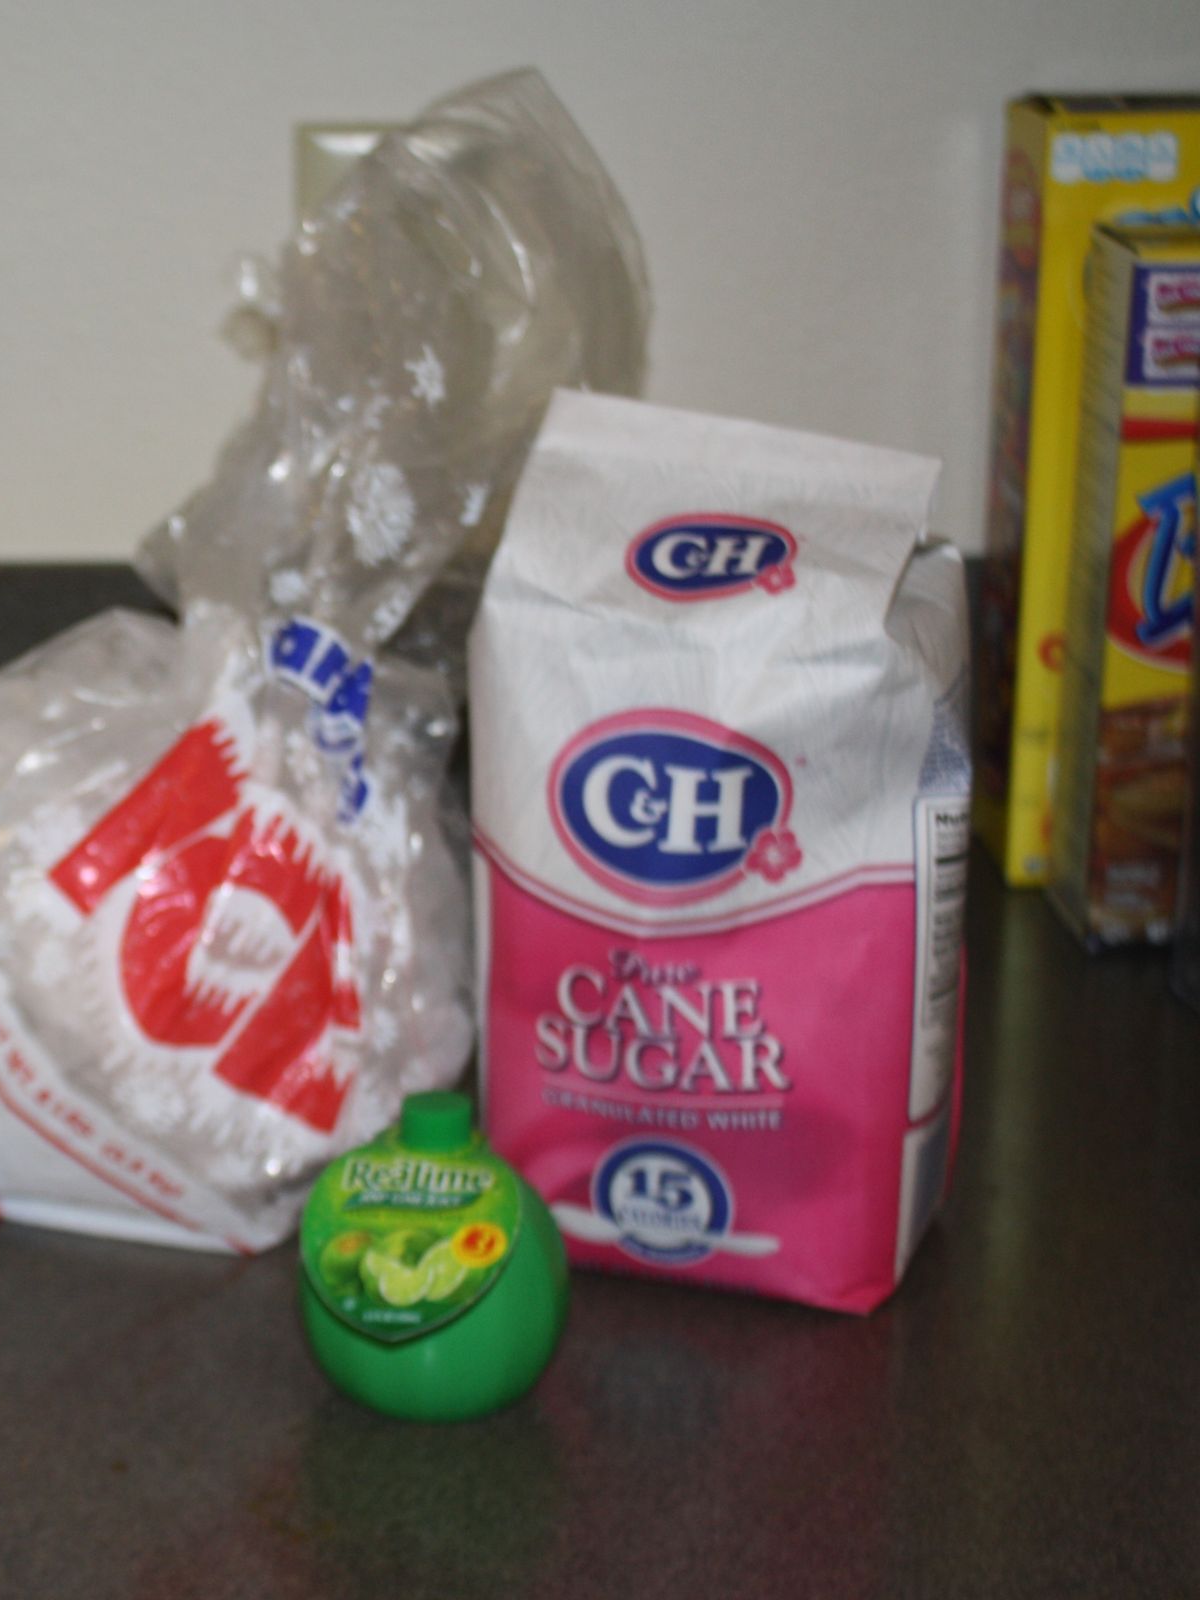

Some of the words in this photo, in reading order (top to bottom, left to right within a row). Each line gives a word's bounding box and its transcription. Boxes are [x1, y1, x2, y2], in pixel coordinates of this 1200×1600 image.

[651, 531, 774, 580] C&H
[581, 754, 754, 855] C&H
[557, 964, 765, 1041] CANE
[535, 1011, 790, 1092] SUGAR
[541, 1088, 699, 1130] GRANULATED
[706, 1108, 785, 1132] WHITE
[628, 1167, 695, 1212] 15
